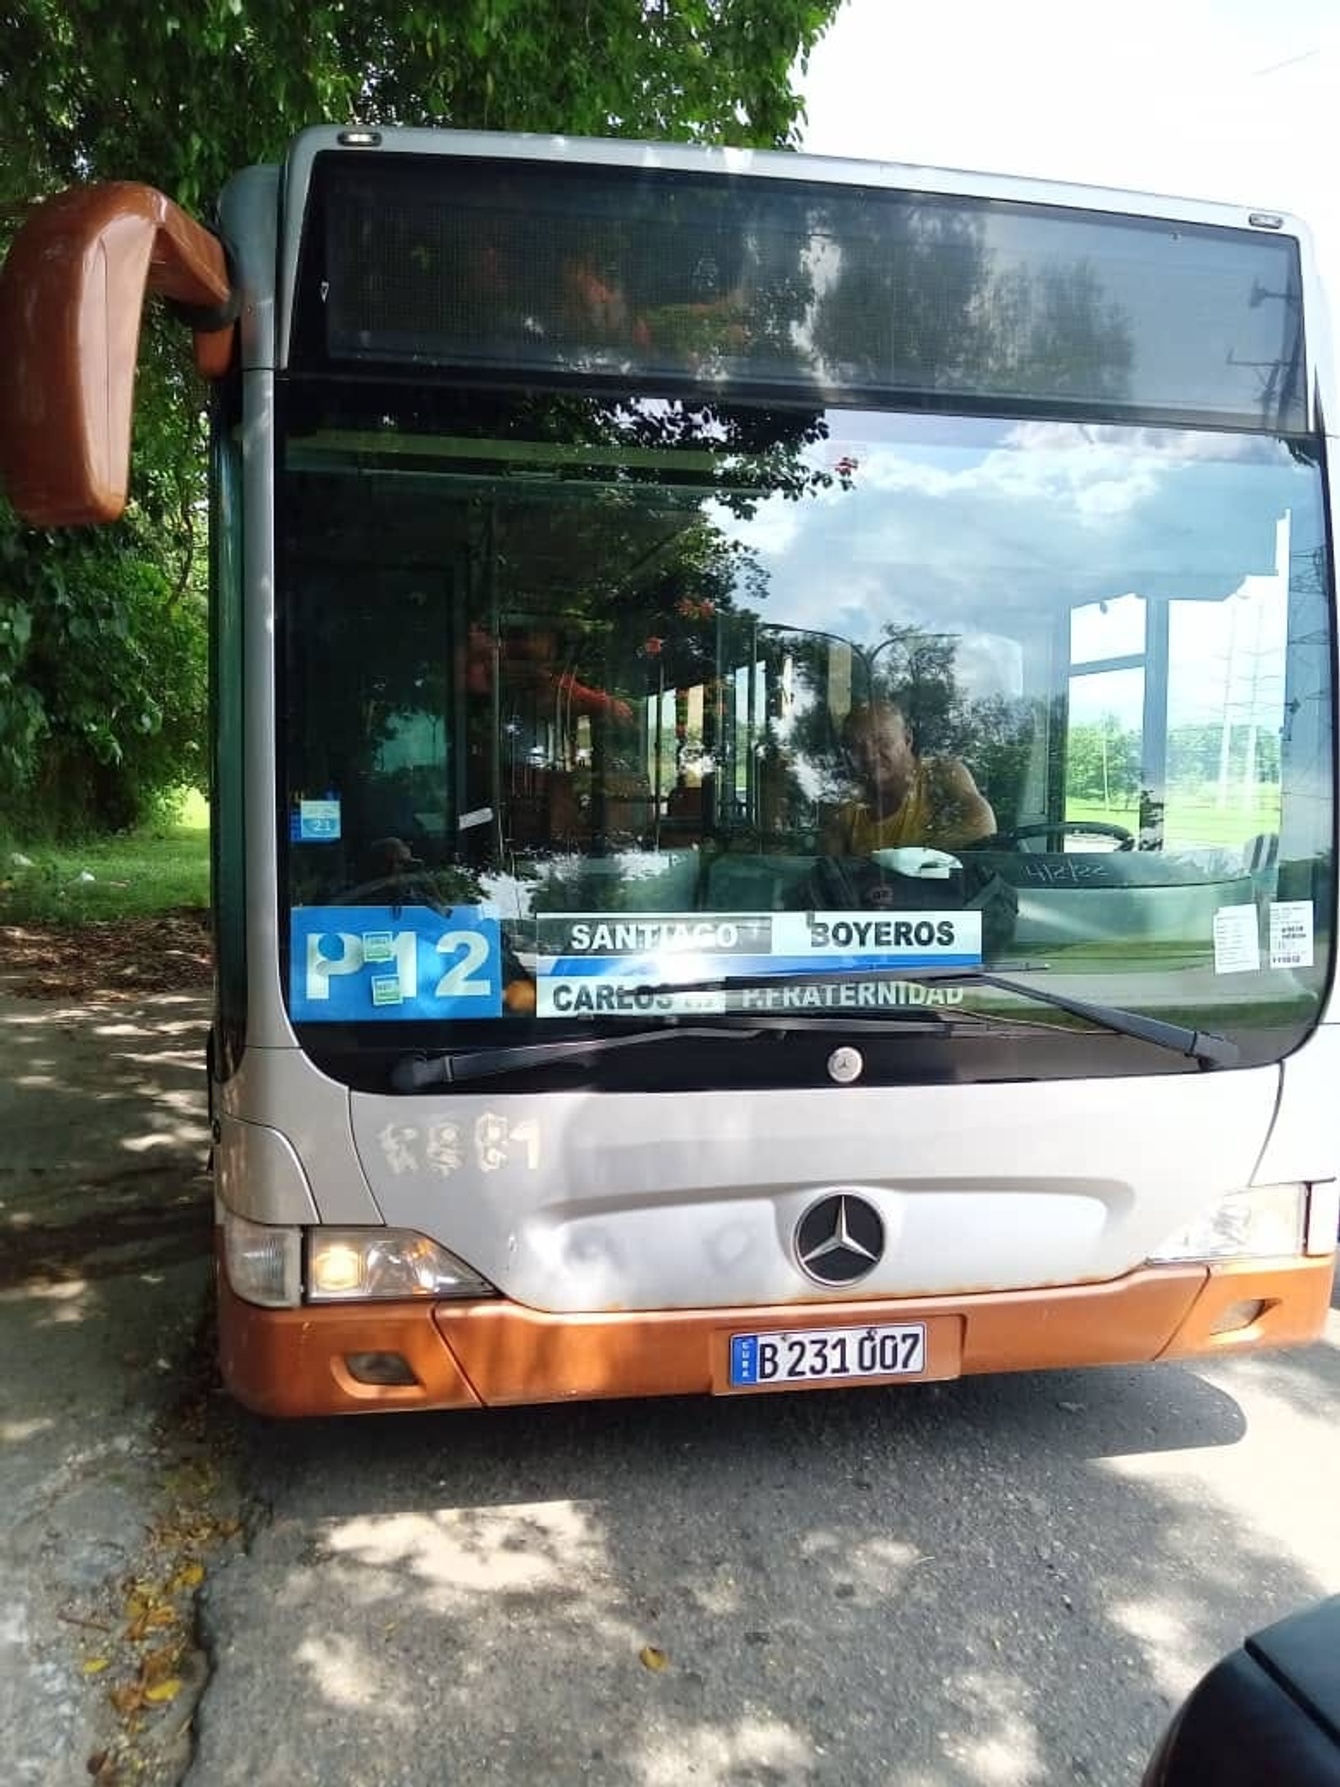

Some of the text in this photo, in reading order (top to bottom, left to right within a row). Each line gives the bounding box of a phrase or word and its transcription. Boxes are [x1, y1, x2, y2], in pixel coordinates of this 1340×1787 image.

[571, 923, 739, 950] SANTIAGO
[811, 921, 955, 947] BOYEROS
[306, 931, 492, 999] P12
